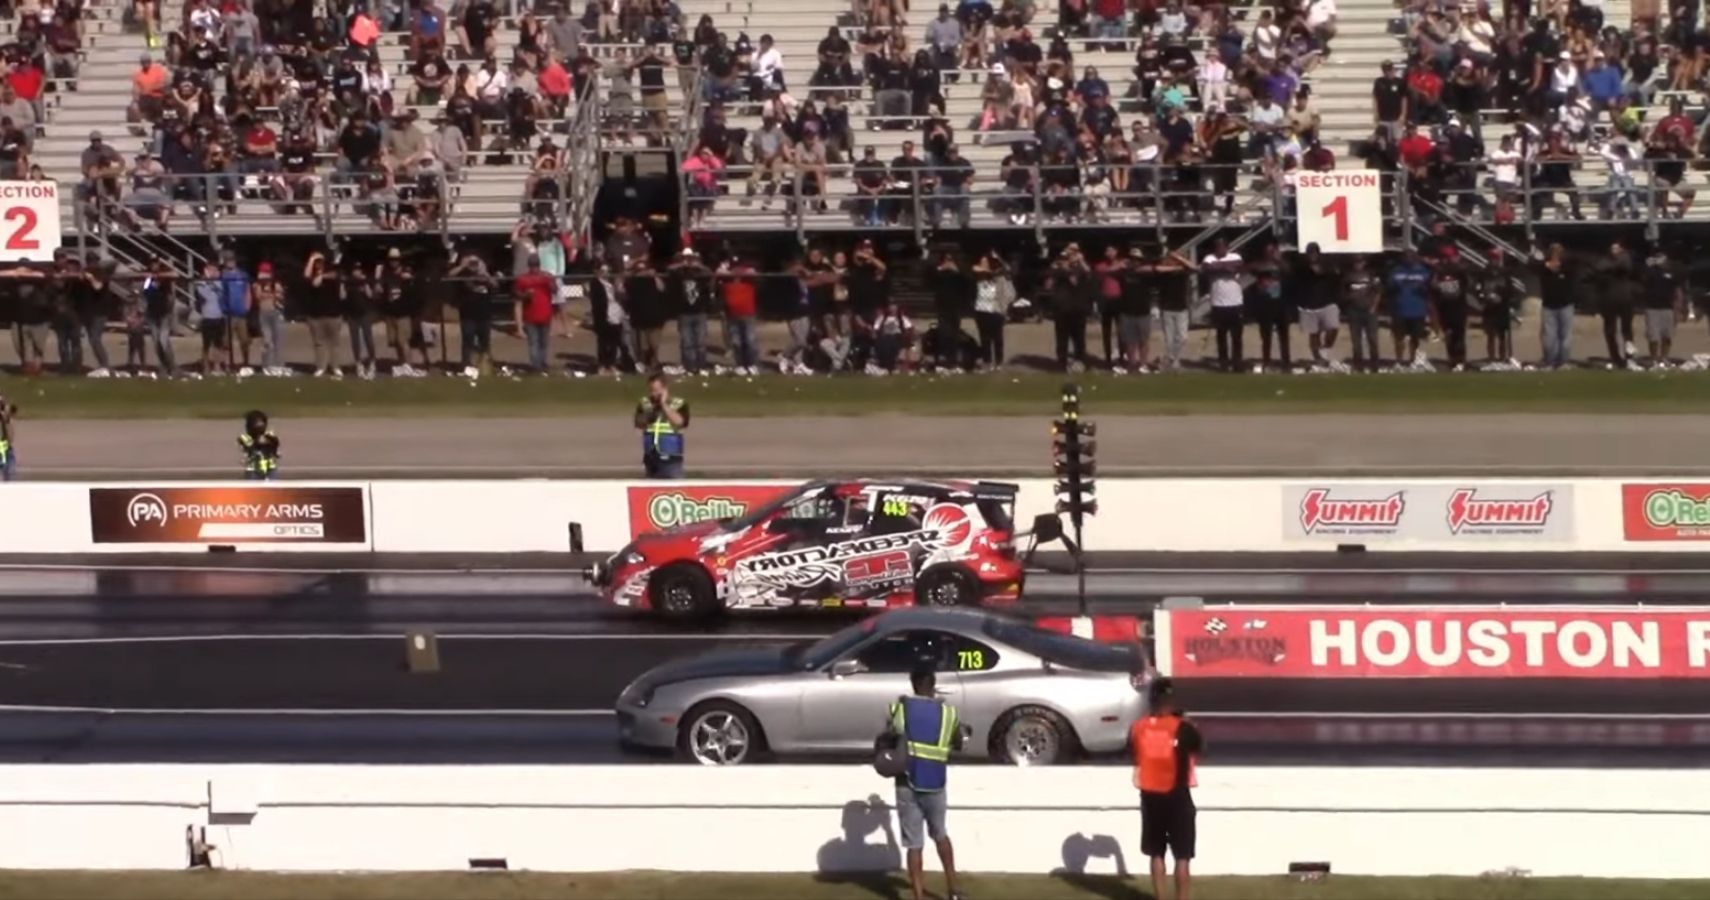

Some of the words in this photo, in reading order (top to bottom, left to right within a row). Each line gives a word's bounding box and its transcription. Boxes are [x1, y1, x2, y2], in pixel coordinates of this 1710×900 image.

[1299, 174, 1376, 188] SECTION
[0, 186, 55, 199] CTION
[1322, 195, 1348, 241] 1
[4, 206, 40, 249] 2
[133, 503, 163, 521] PA
[173, 504, 262, 518] PRIMARY
[265, 504, 324, 518] ARMS
[882, 501, 908, 517] 443
[273, 525, 320, 535] OPTICS
[1310, 619, 1660, 668] HOUSTON
[958, 651, 983, 669] 713
